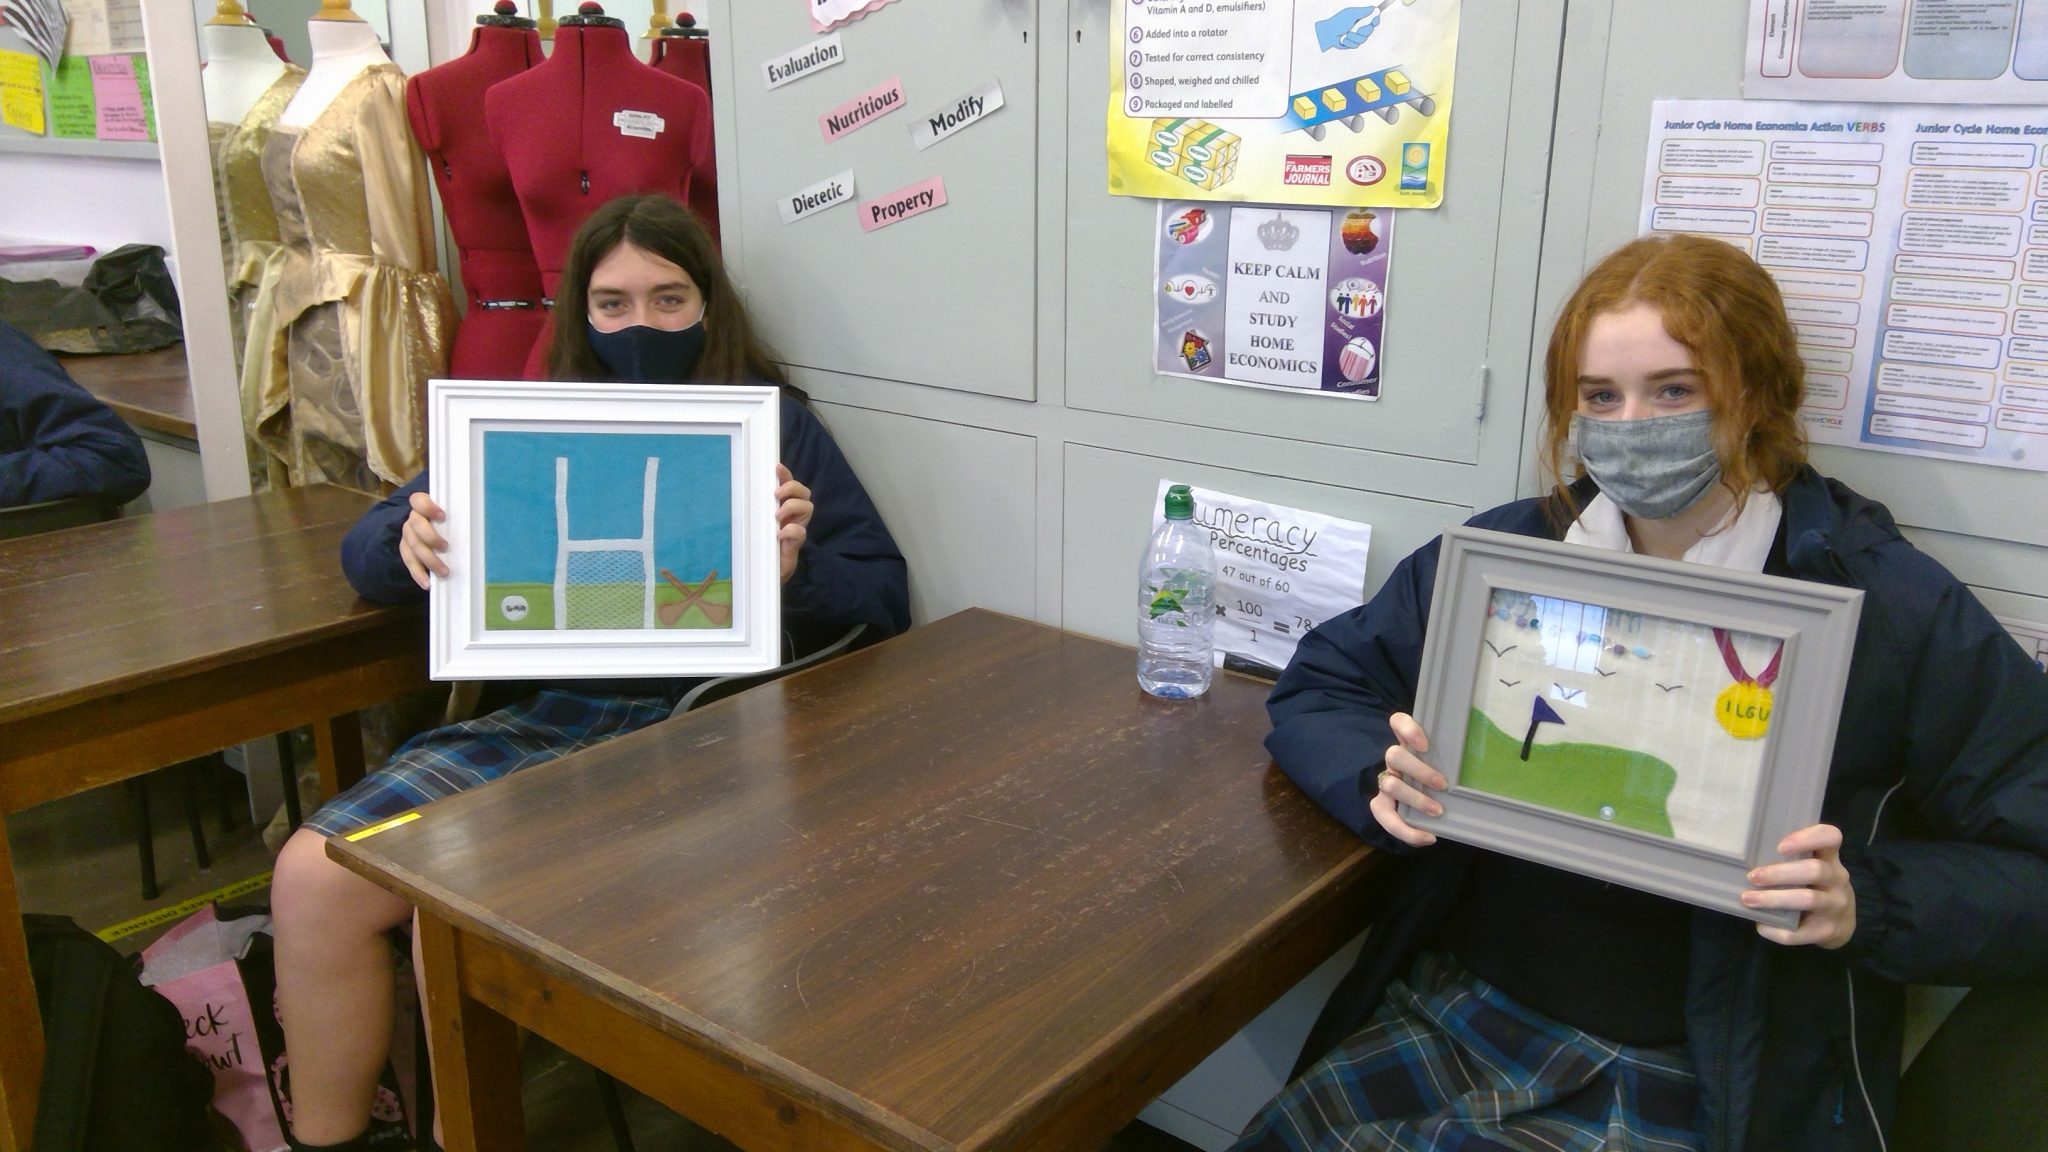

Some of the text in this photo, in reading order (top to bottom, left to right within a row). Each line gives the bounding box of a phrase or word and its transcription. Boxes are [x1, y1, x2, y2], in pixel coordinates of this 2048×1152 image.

[1147, 5, 1178, 15] Vitamin
[1179, 5, 1186, 14] A
[1188, 4, 1203, 13] and
[1146, 29, 1171, 39] Added
[1173, 30, 1189, 38] into
[1199, 29, 1228, 38] rotator
[767, 42, 839, 83] Evaluation
[1145, 53, 1171, 63] Tested
[1172, 53, 1185, 62] for
[1186, 53, 1214, 61] correct
[1217, 52, 1265, 63] consistency
[1145, 76, 1177, 88] Shaped,
[1178, 75, 1213, 87] weighed
[1214, 76, 1230, 84] and
[1232, 75, 1260, 84] chilled
[826, 87, 900, 136] Nutritious
[1145, 99, 1182, 110] Packaged
[1184, 100, 1199, 109] and
[1201, 99, 1233, 109] labelled
[928, 95, 985, 137] Modify
[1664, 120, 1886, 133] Junior Cycle Home Economics Action VERBS
[1915, 123, 1950, 134] Junior
[1953, 123, 1983, 136] Cycle
[1985, 124, 2020, 135] Home
[1285, 164, 1331, 173] FARMERS
[1285, 173, 1330, 185] JOURNAL
[791, 181, 844, 215] Dietetic
[871, 186, 935, 223] Property
[1234, 262, 1272, 277] KEEP
[1275, 264, 1321, 281] CALM
[1259, 291, 1290, 305] AND
[1249, 312, 1298, 329] STUDY
[1250, 335, 1295, 351] HOME
[1229, 353, 1319, 374] ECONOMICS
[1194, 502, 1317, 554] umeracy
[1210, 531, 1307, 572] Percentages
[1222, 565, 1290, 593] 47 out of 60
[1237, 600, 1263, 617] 100
[1294, 615, 1312, 632] 78
[1250, 629, 1258, 642] 1
[111, 909, 179, 937] DISTANCE
